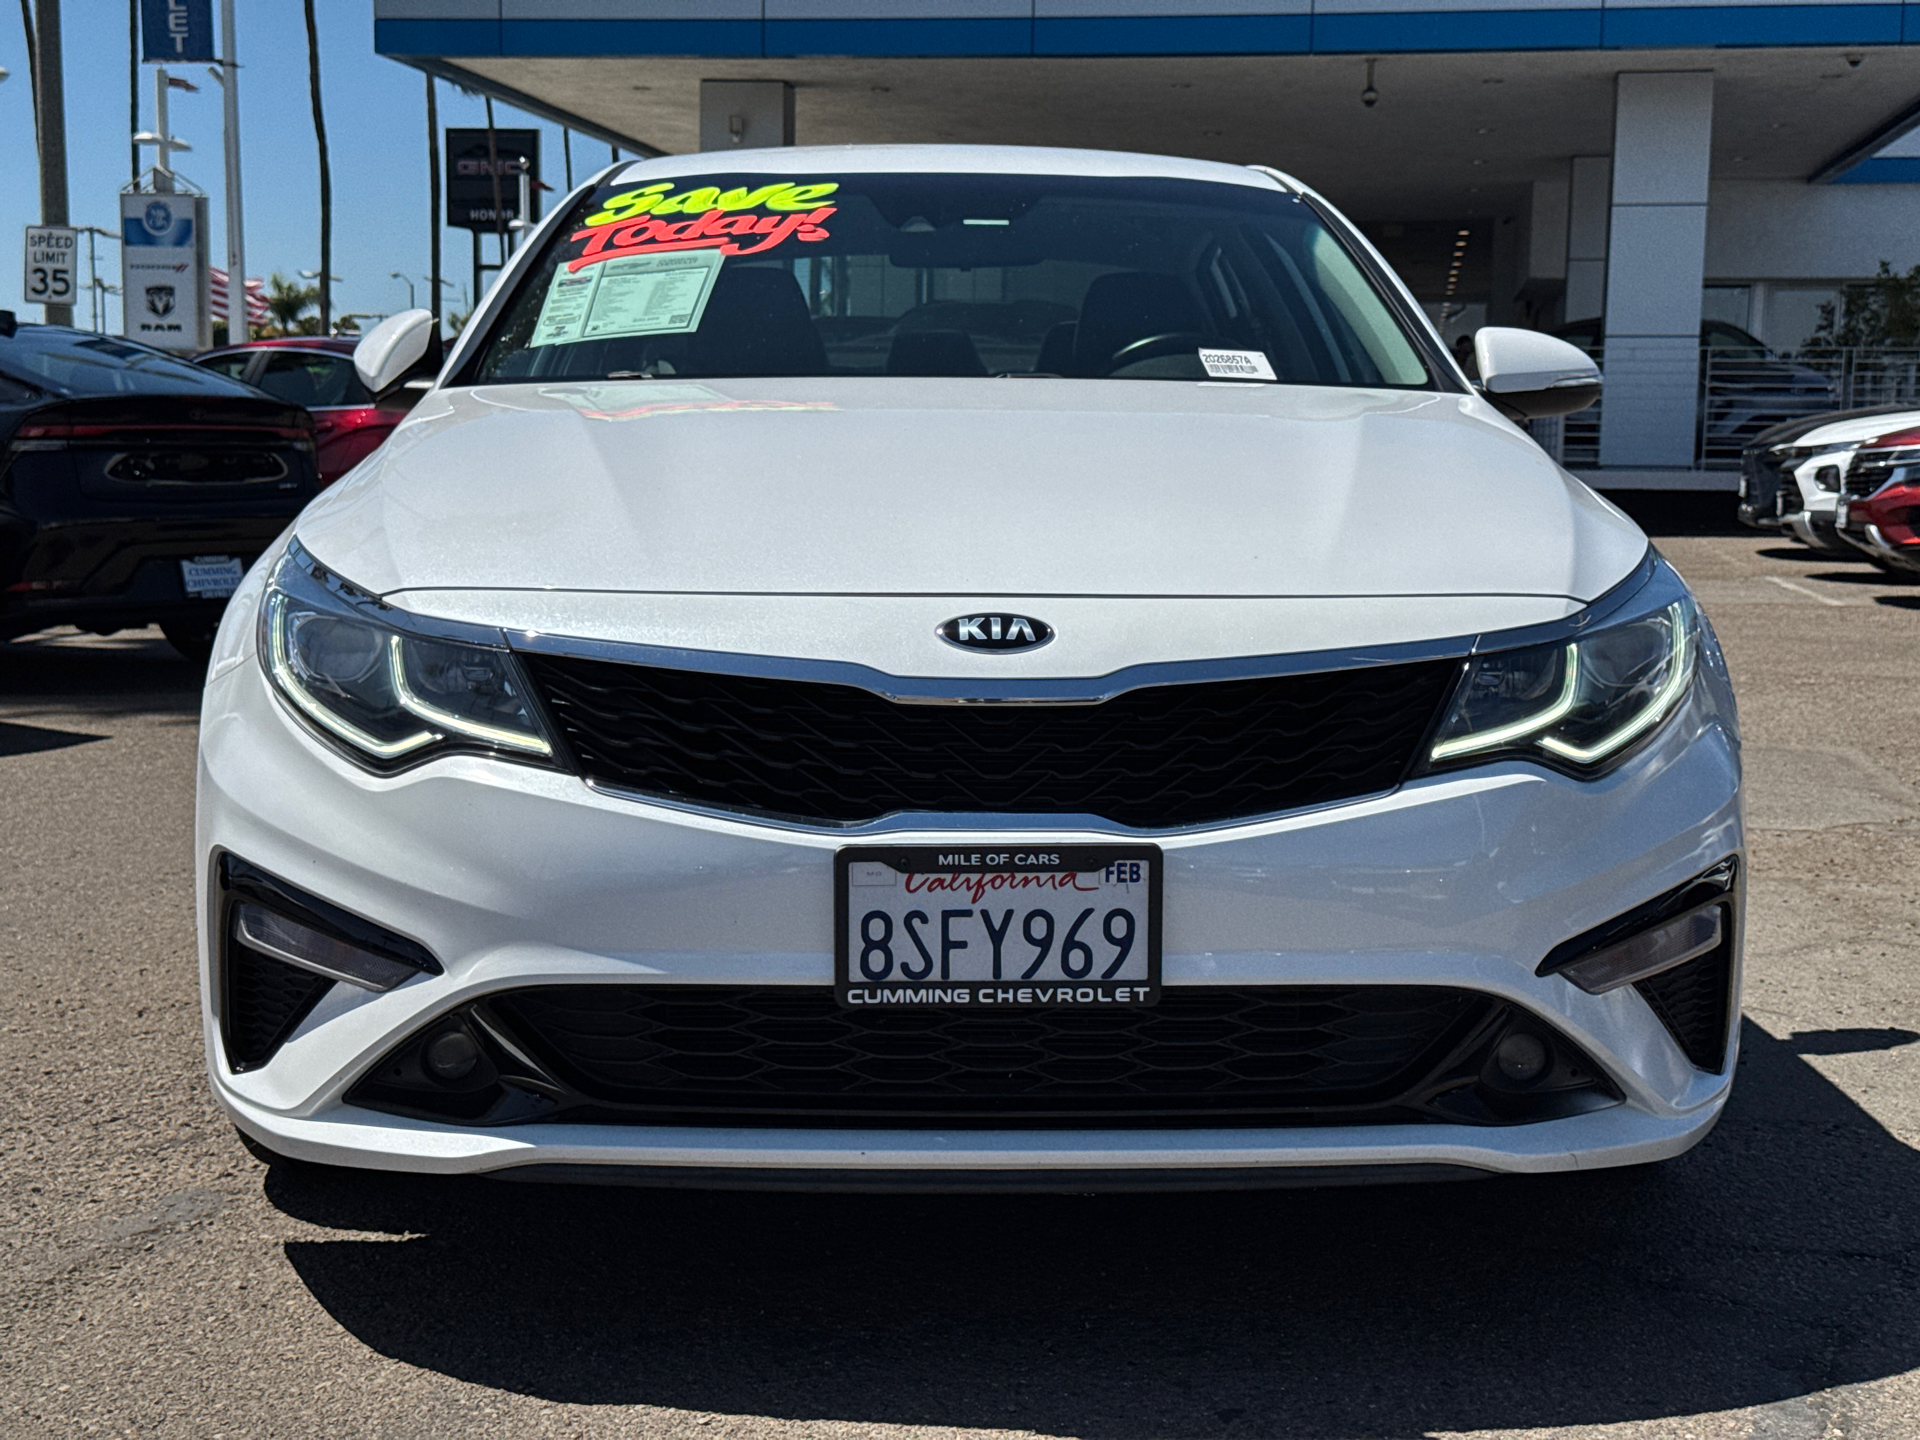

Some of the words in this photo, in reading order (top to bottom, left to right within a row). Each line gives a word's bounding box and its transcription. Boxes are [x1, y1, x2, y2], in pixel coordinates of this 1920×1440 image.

[457, 160, 524, 175] GMC
[585, 182, 839, 226] Save
[30, 233, 73, 249] SPEED
[33, 251, 67, 264] LIMIT
[31, 267, 70, 297] 35
[140, 323, 182, 332] RAM
[189, 566, 238, 576] CUMMING
[958, 617, 1036, 641] KIA
[938, 854, 981, 866] MILE
[985, 854, 1010, 866] OF
[1014, 853, 1060, 866] CARS
[1105, 862, 1141, 883] FEB
[905, 872, 1099, 904] California
[859, 907, 1136, 981] 8SFY969
[847, 988, 970, 1004] CUMMING
[978, 987, 1150, 1004] CHEVROLET
